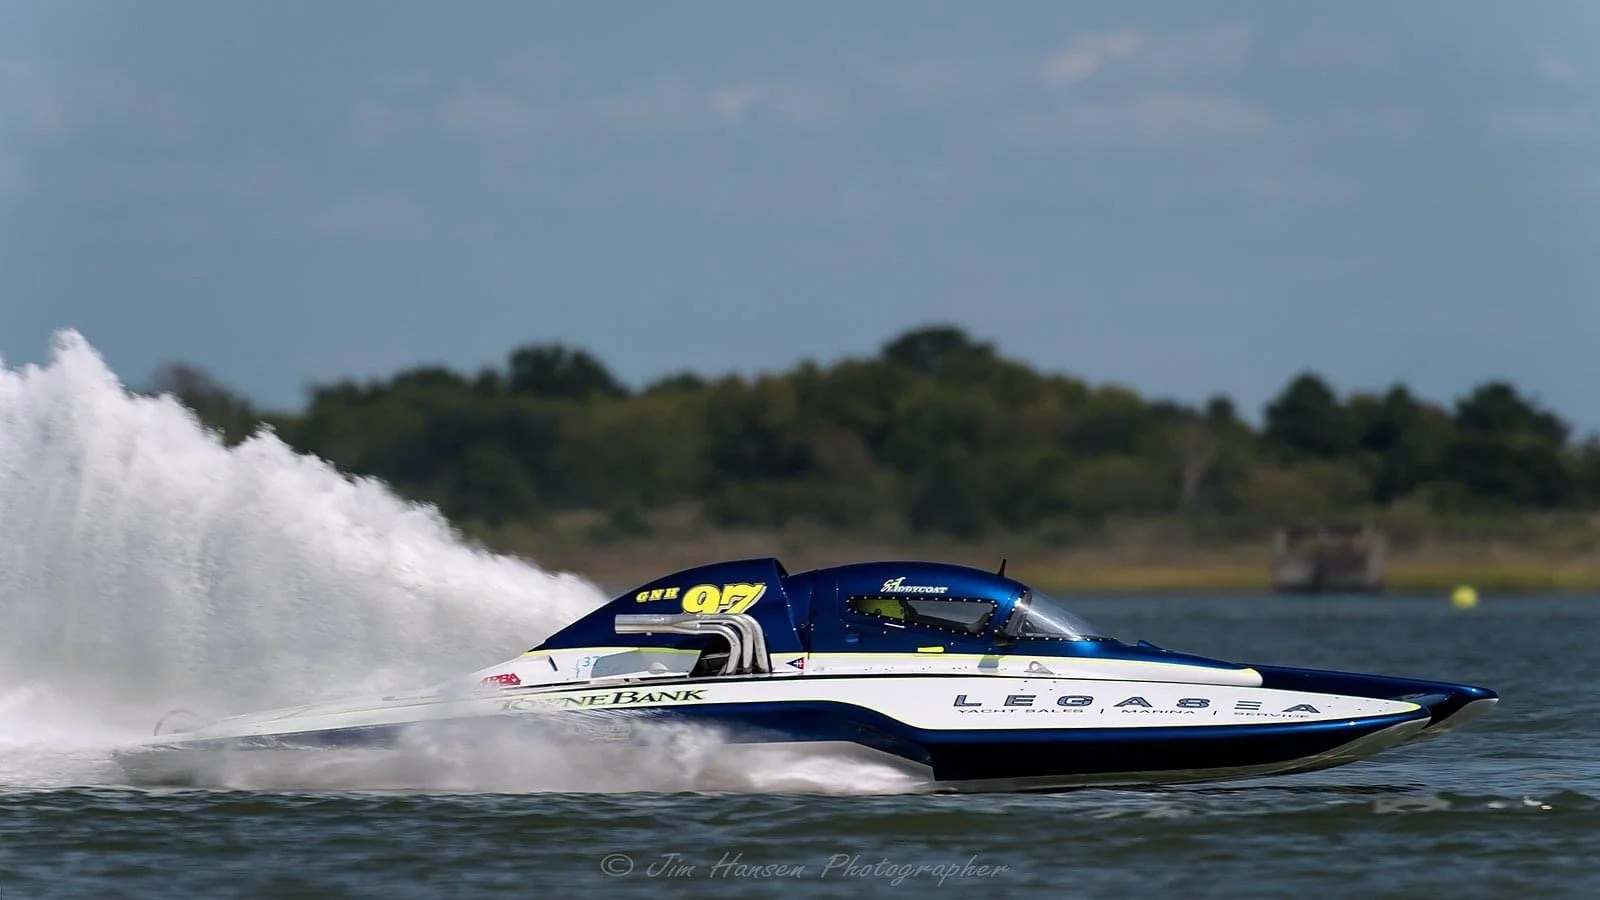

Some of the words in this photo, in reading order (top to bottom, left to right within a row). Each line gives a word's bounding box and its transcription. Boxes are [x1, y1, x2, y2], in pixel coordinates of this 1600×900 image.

[636, 587, 680, 603] GNH
[682, 583, 767, 615] 97
[953, 694, 1321, 714] LEGASEA
